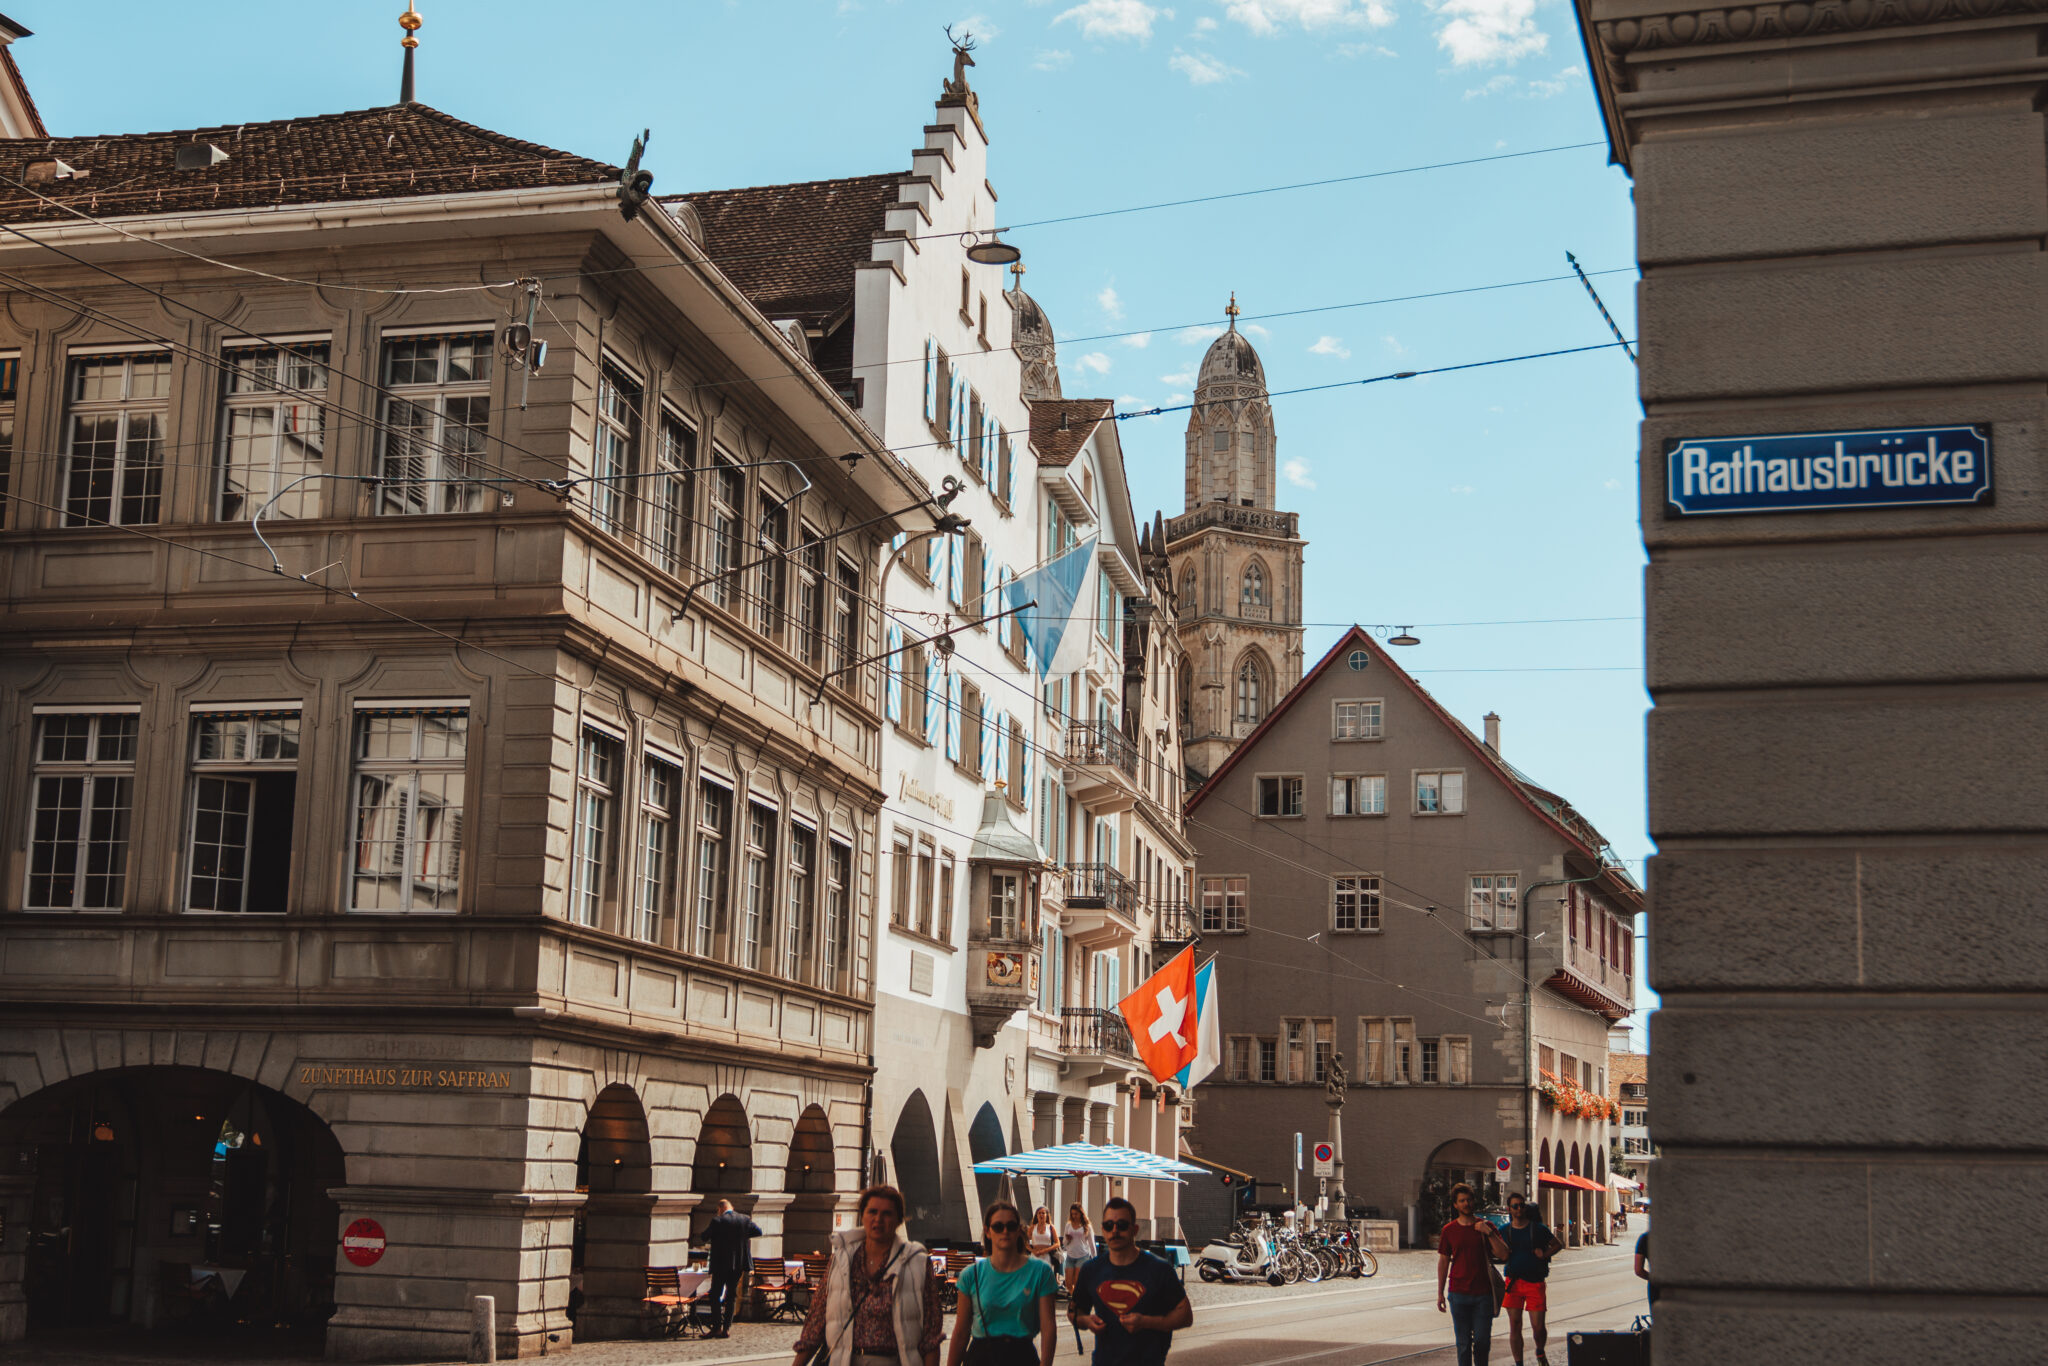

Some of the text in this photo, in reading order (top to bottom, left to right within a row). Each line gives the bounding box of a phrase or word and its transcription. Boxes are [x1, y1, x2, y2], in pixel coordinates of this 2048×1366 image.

[1682, 436, 1975, 496] Rathausbrücke
[301, 1067, 511, 1089] ZUNFTHAUS ZUR SAFFRAN
